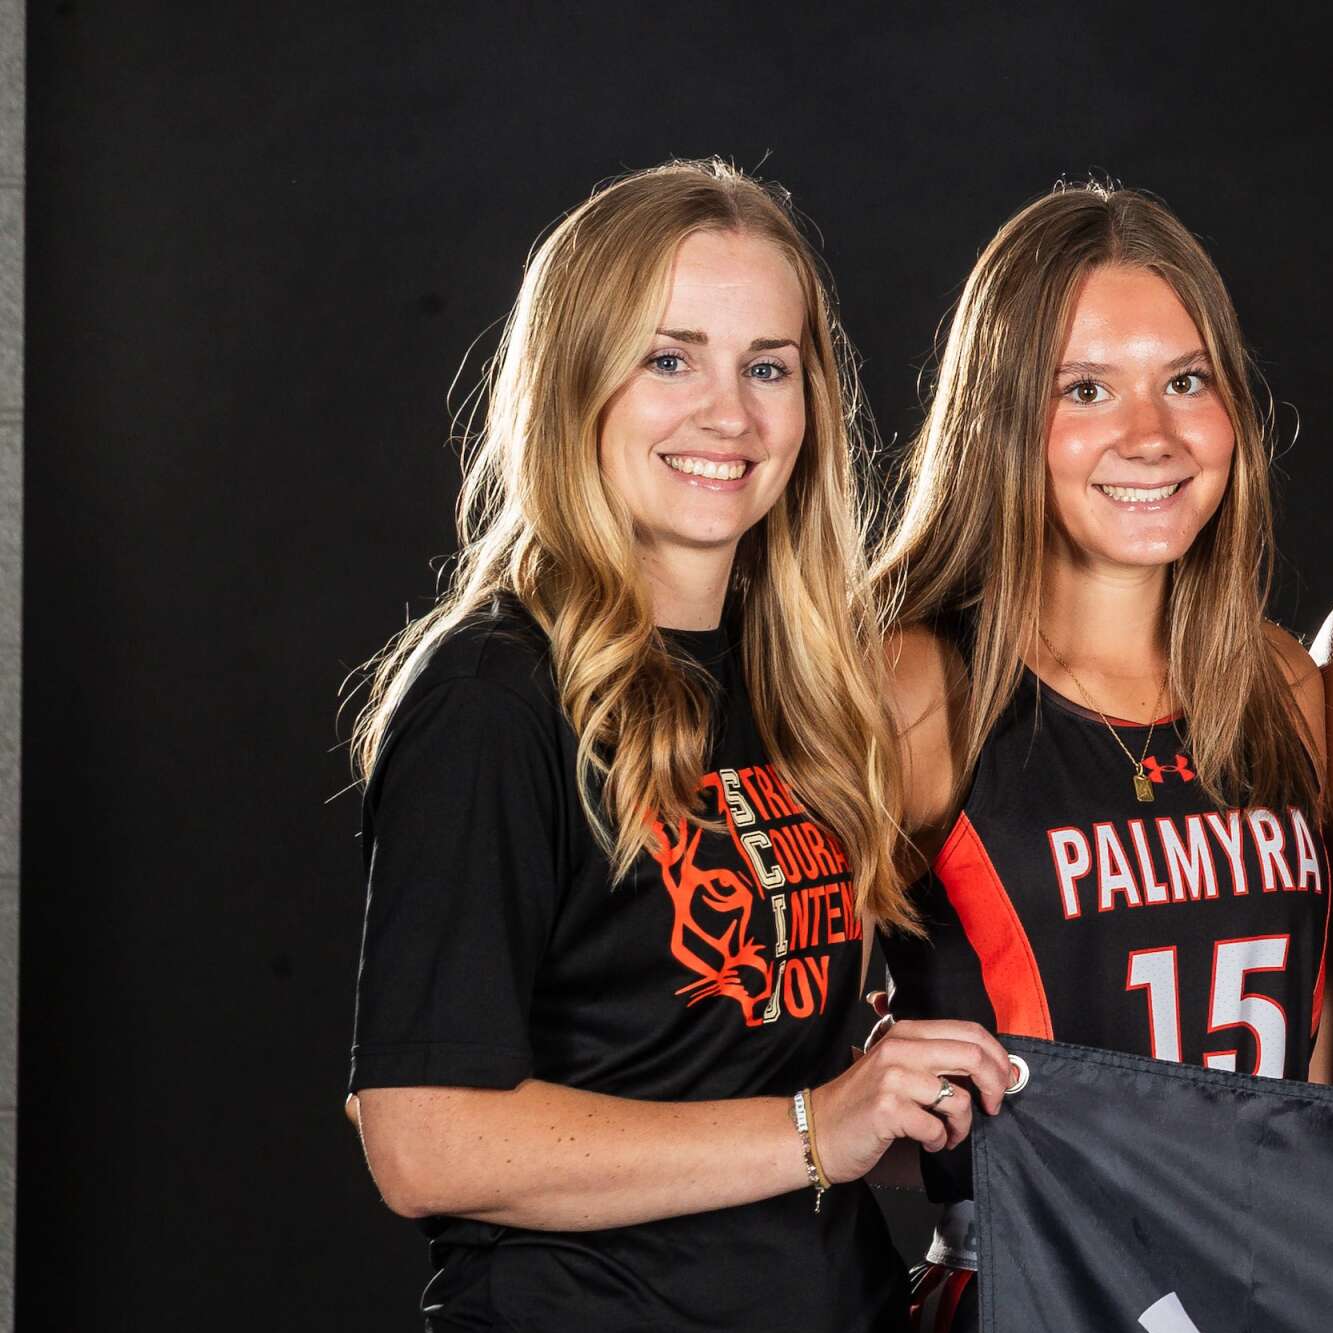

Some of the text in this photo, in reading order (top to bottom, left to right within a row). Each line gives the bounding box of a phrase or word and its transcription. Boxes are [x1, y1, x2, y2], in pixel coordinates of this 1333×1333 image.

[1047, 806, 1323, 920] PALMYRA
[763, 956, 830, 1024] JOY
[1125, 934, 1290, 1079] 15
